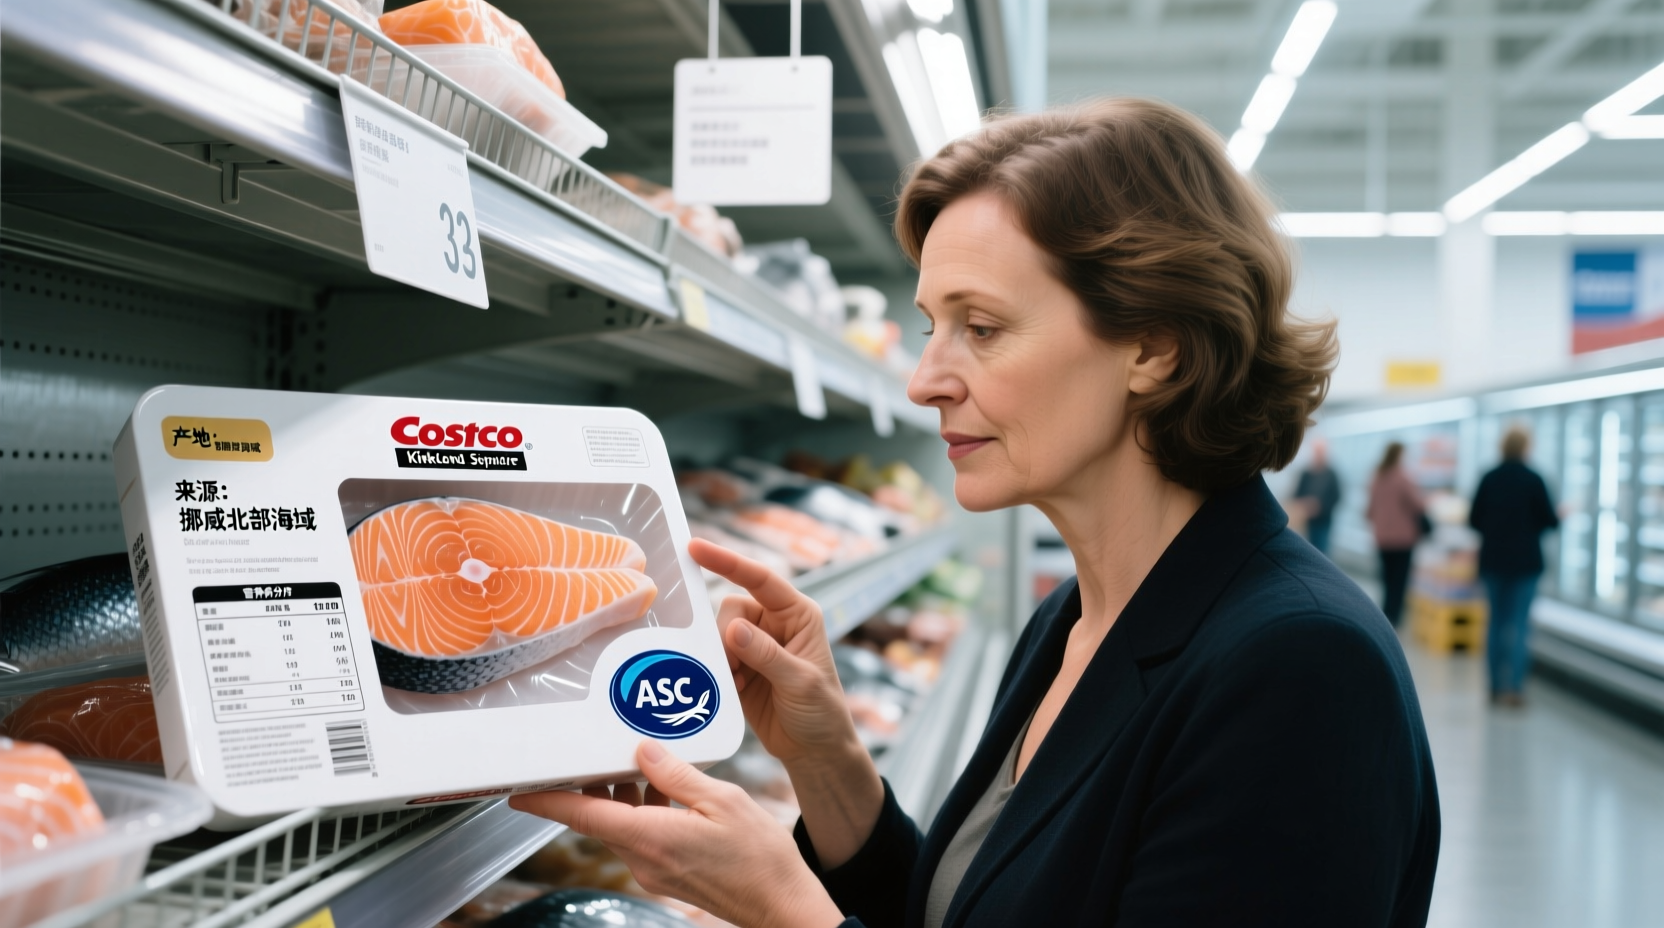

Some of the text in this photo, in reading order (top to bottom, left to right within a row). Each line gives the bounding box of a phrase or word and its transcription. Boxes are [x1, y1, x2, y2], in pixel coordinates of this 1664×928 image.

[439, 202, 476, 280] 33
[391, 416, 523, 449] Costco
[175, 479, 228, 502] 来源：
[179, 506, 317, 532] 挪威北部海域
[635, 677, 694, 709] ASC
